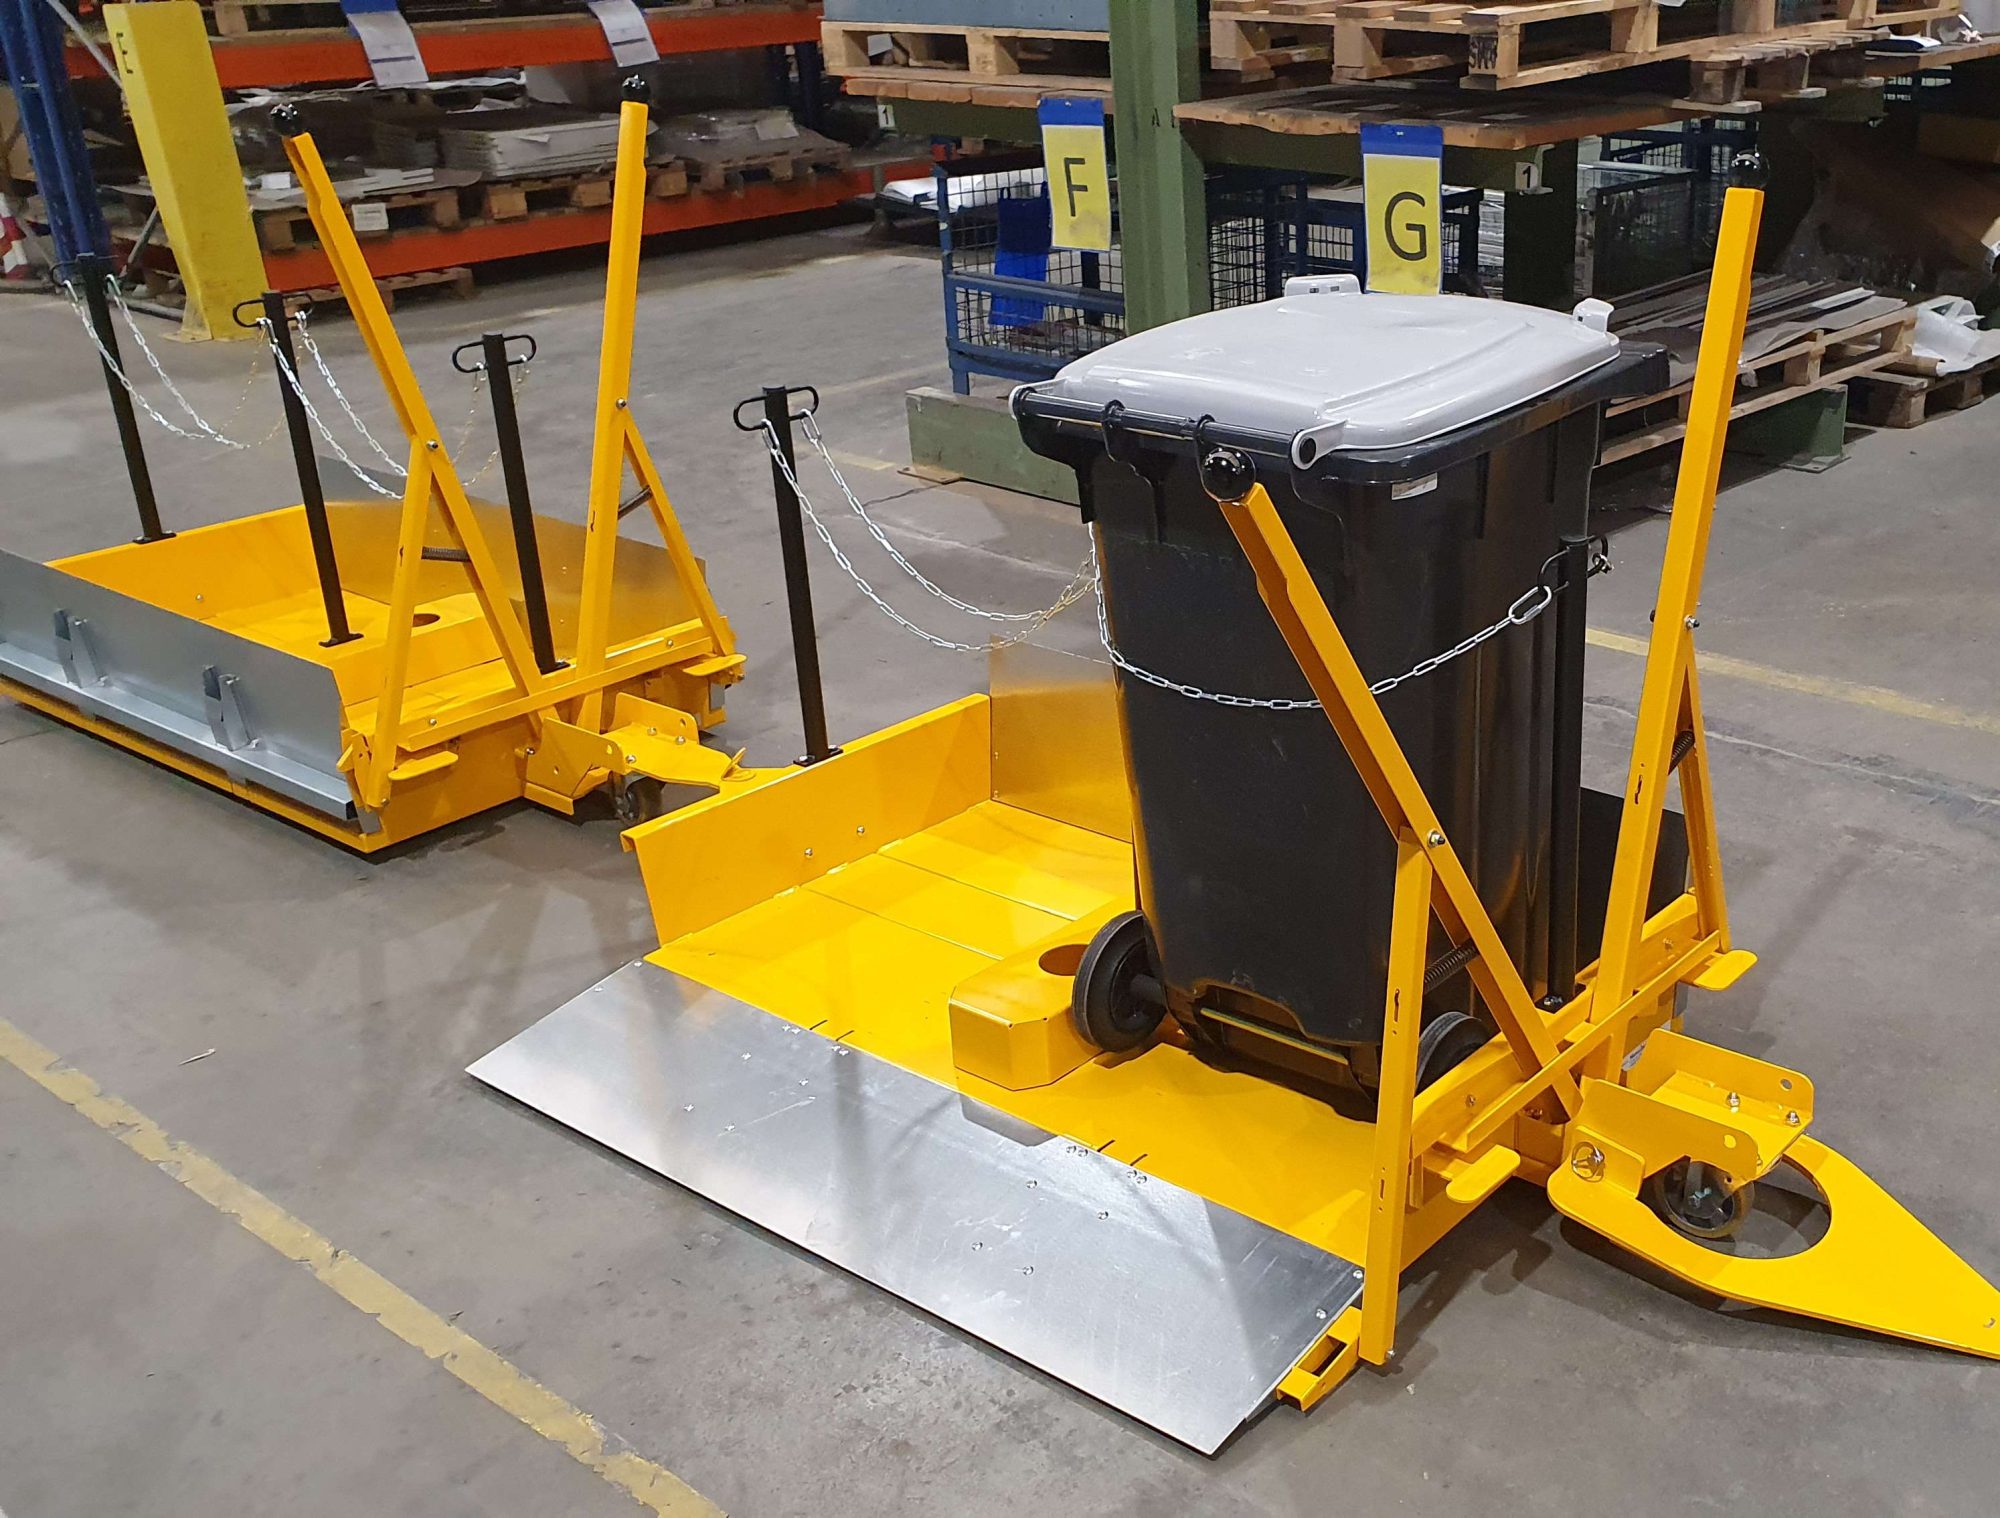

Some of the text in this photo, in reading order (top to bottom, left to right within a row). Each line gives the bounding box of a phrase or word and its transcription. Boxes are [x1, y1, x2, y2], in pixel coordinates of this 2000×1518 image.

[1064, 157, 1088, 217] F
[1523, 165, 1531, 189] 1
[1385, 191, 1427, 261] G
